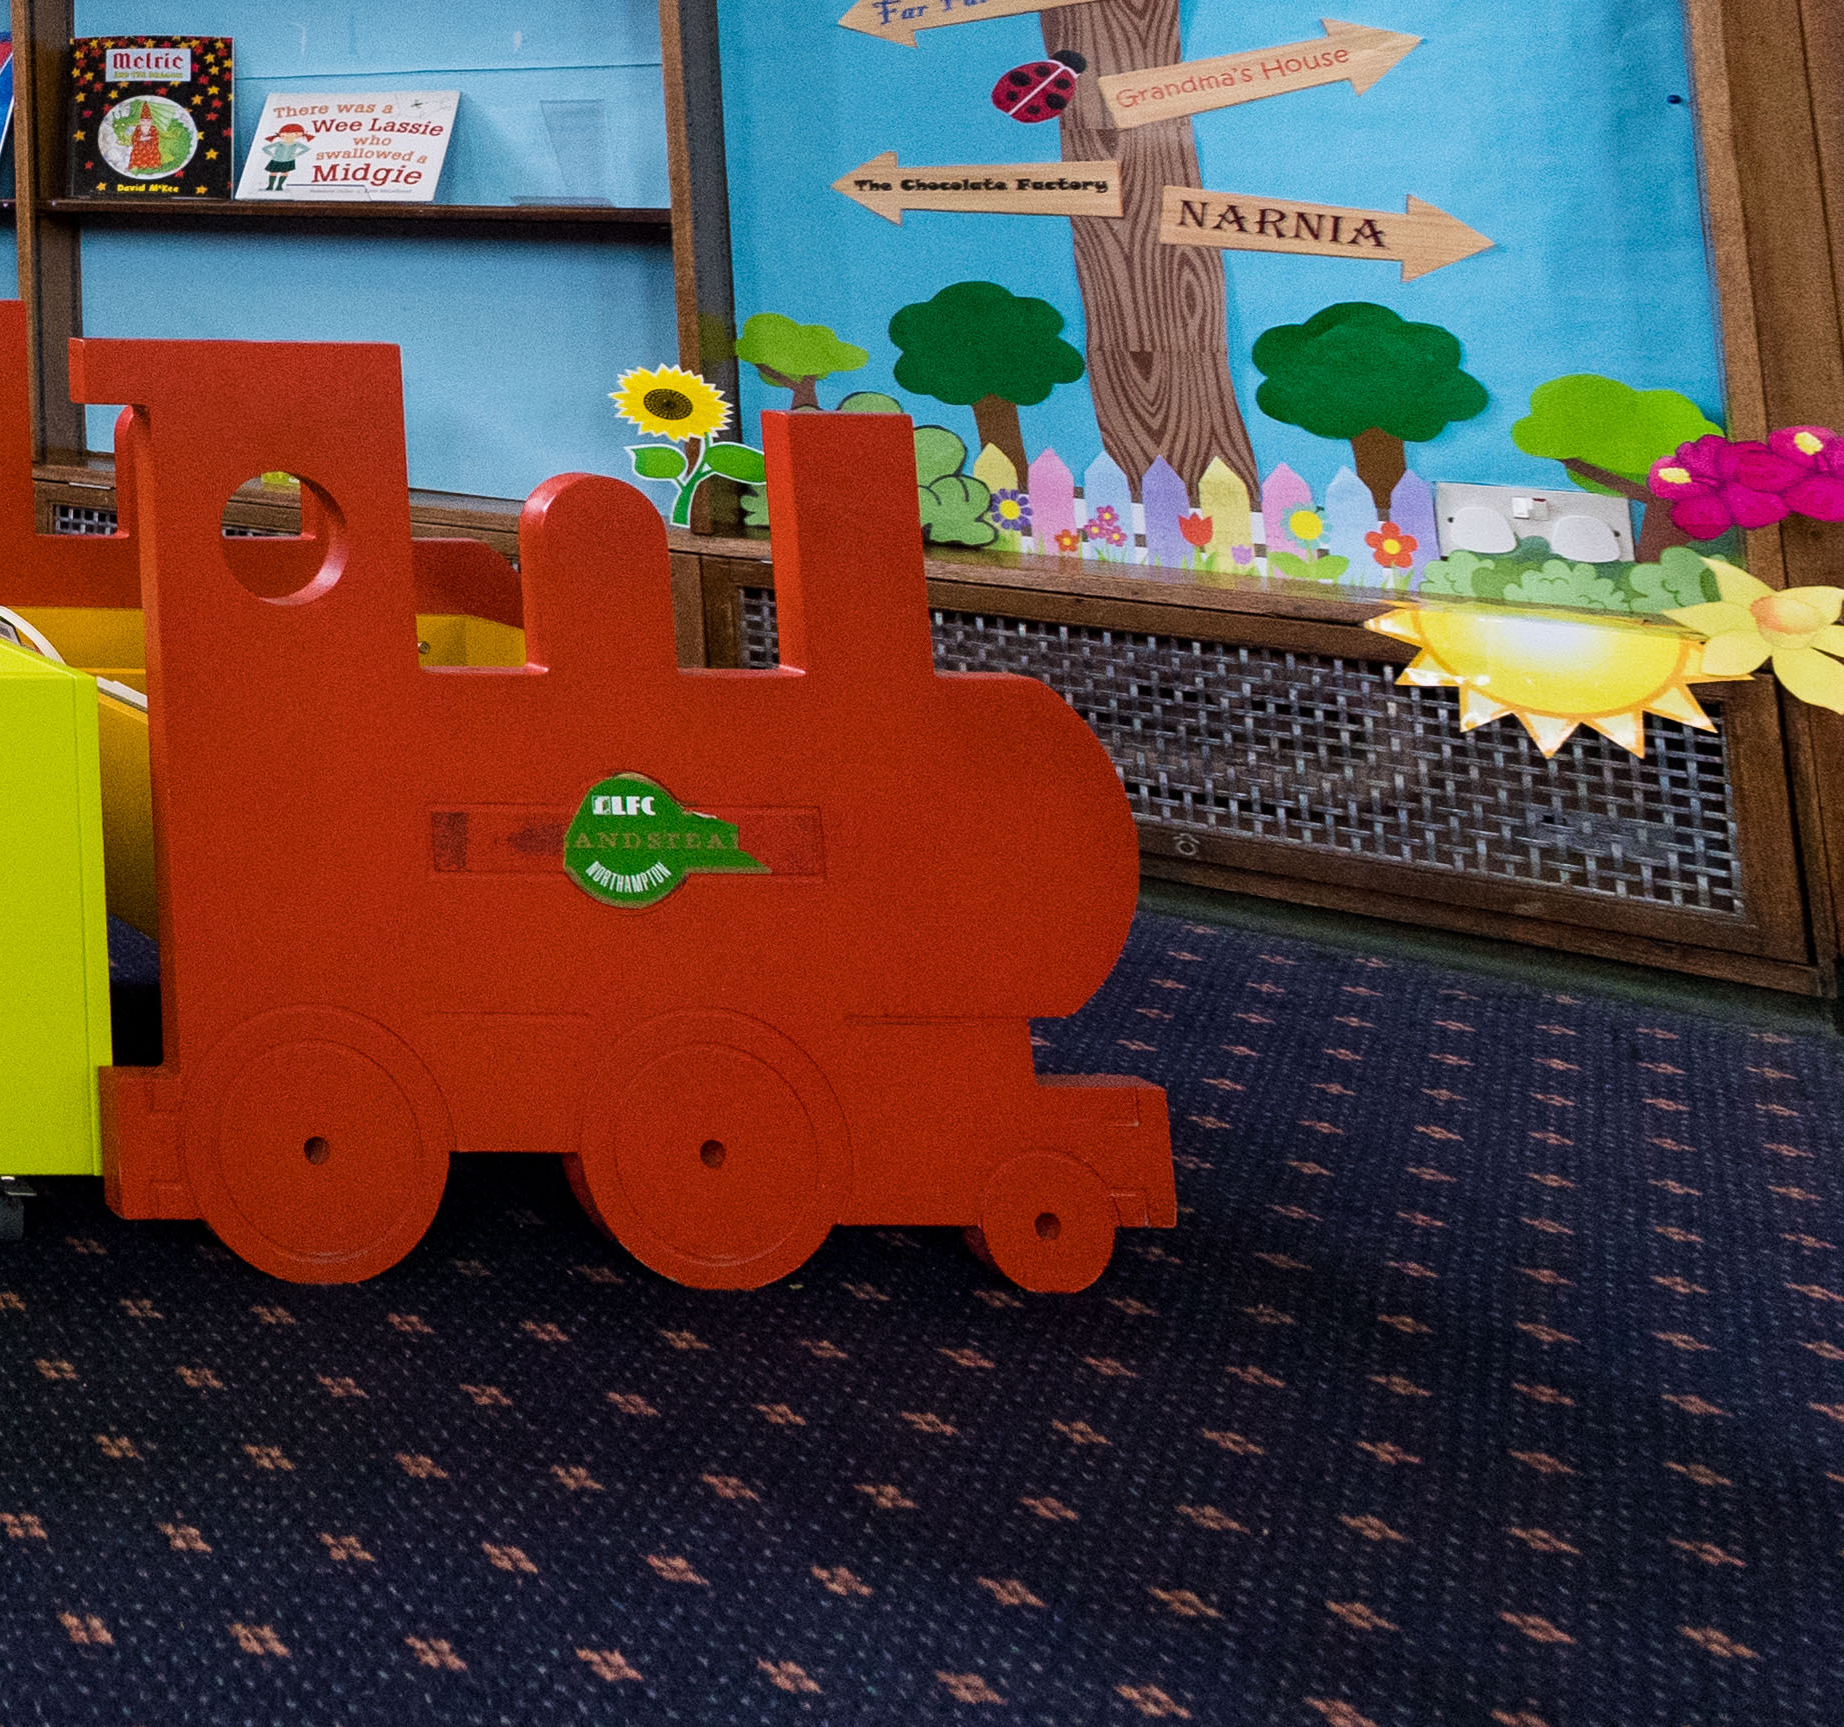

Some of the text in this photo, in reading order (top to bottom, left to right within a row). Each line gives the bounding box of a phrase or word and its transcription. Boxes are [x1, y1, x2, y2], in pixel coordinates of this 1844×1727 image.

[1115, 45, 1350, 110] Grandma's House
[273, 103, 393, 119] There was a
[312, 118, 444, 137] Wee Lassie
[353, 135, 392, 146] who
[316, 148, 428, 164] swallowed a
[312, 163, 422, 187] Midgie
[117, 184, 145, 192] David
[854, 177, 1109, 195] The Chocolate Factory
[1176, 199, 1388, 249] NARNIA
[586, 861, 671, 893] NORTHAMPTON
